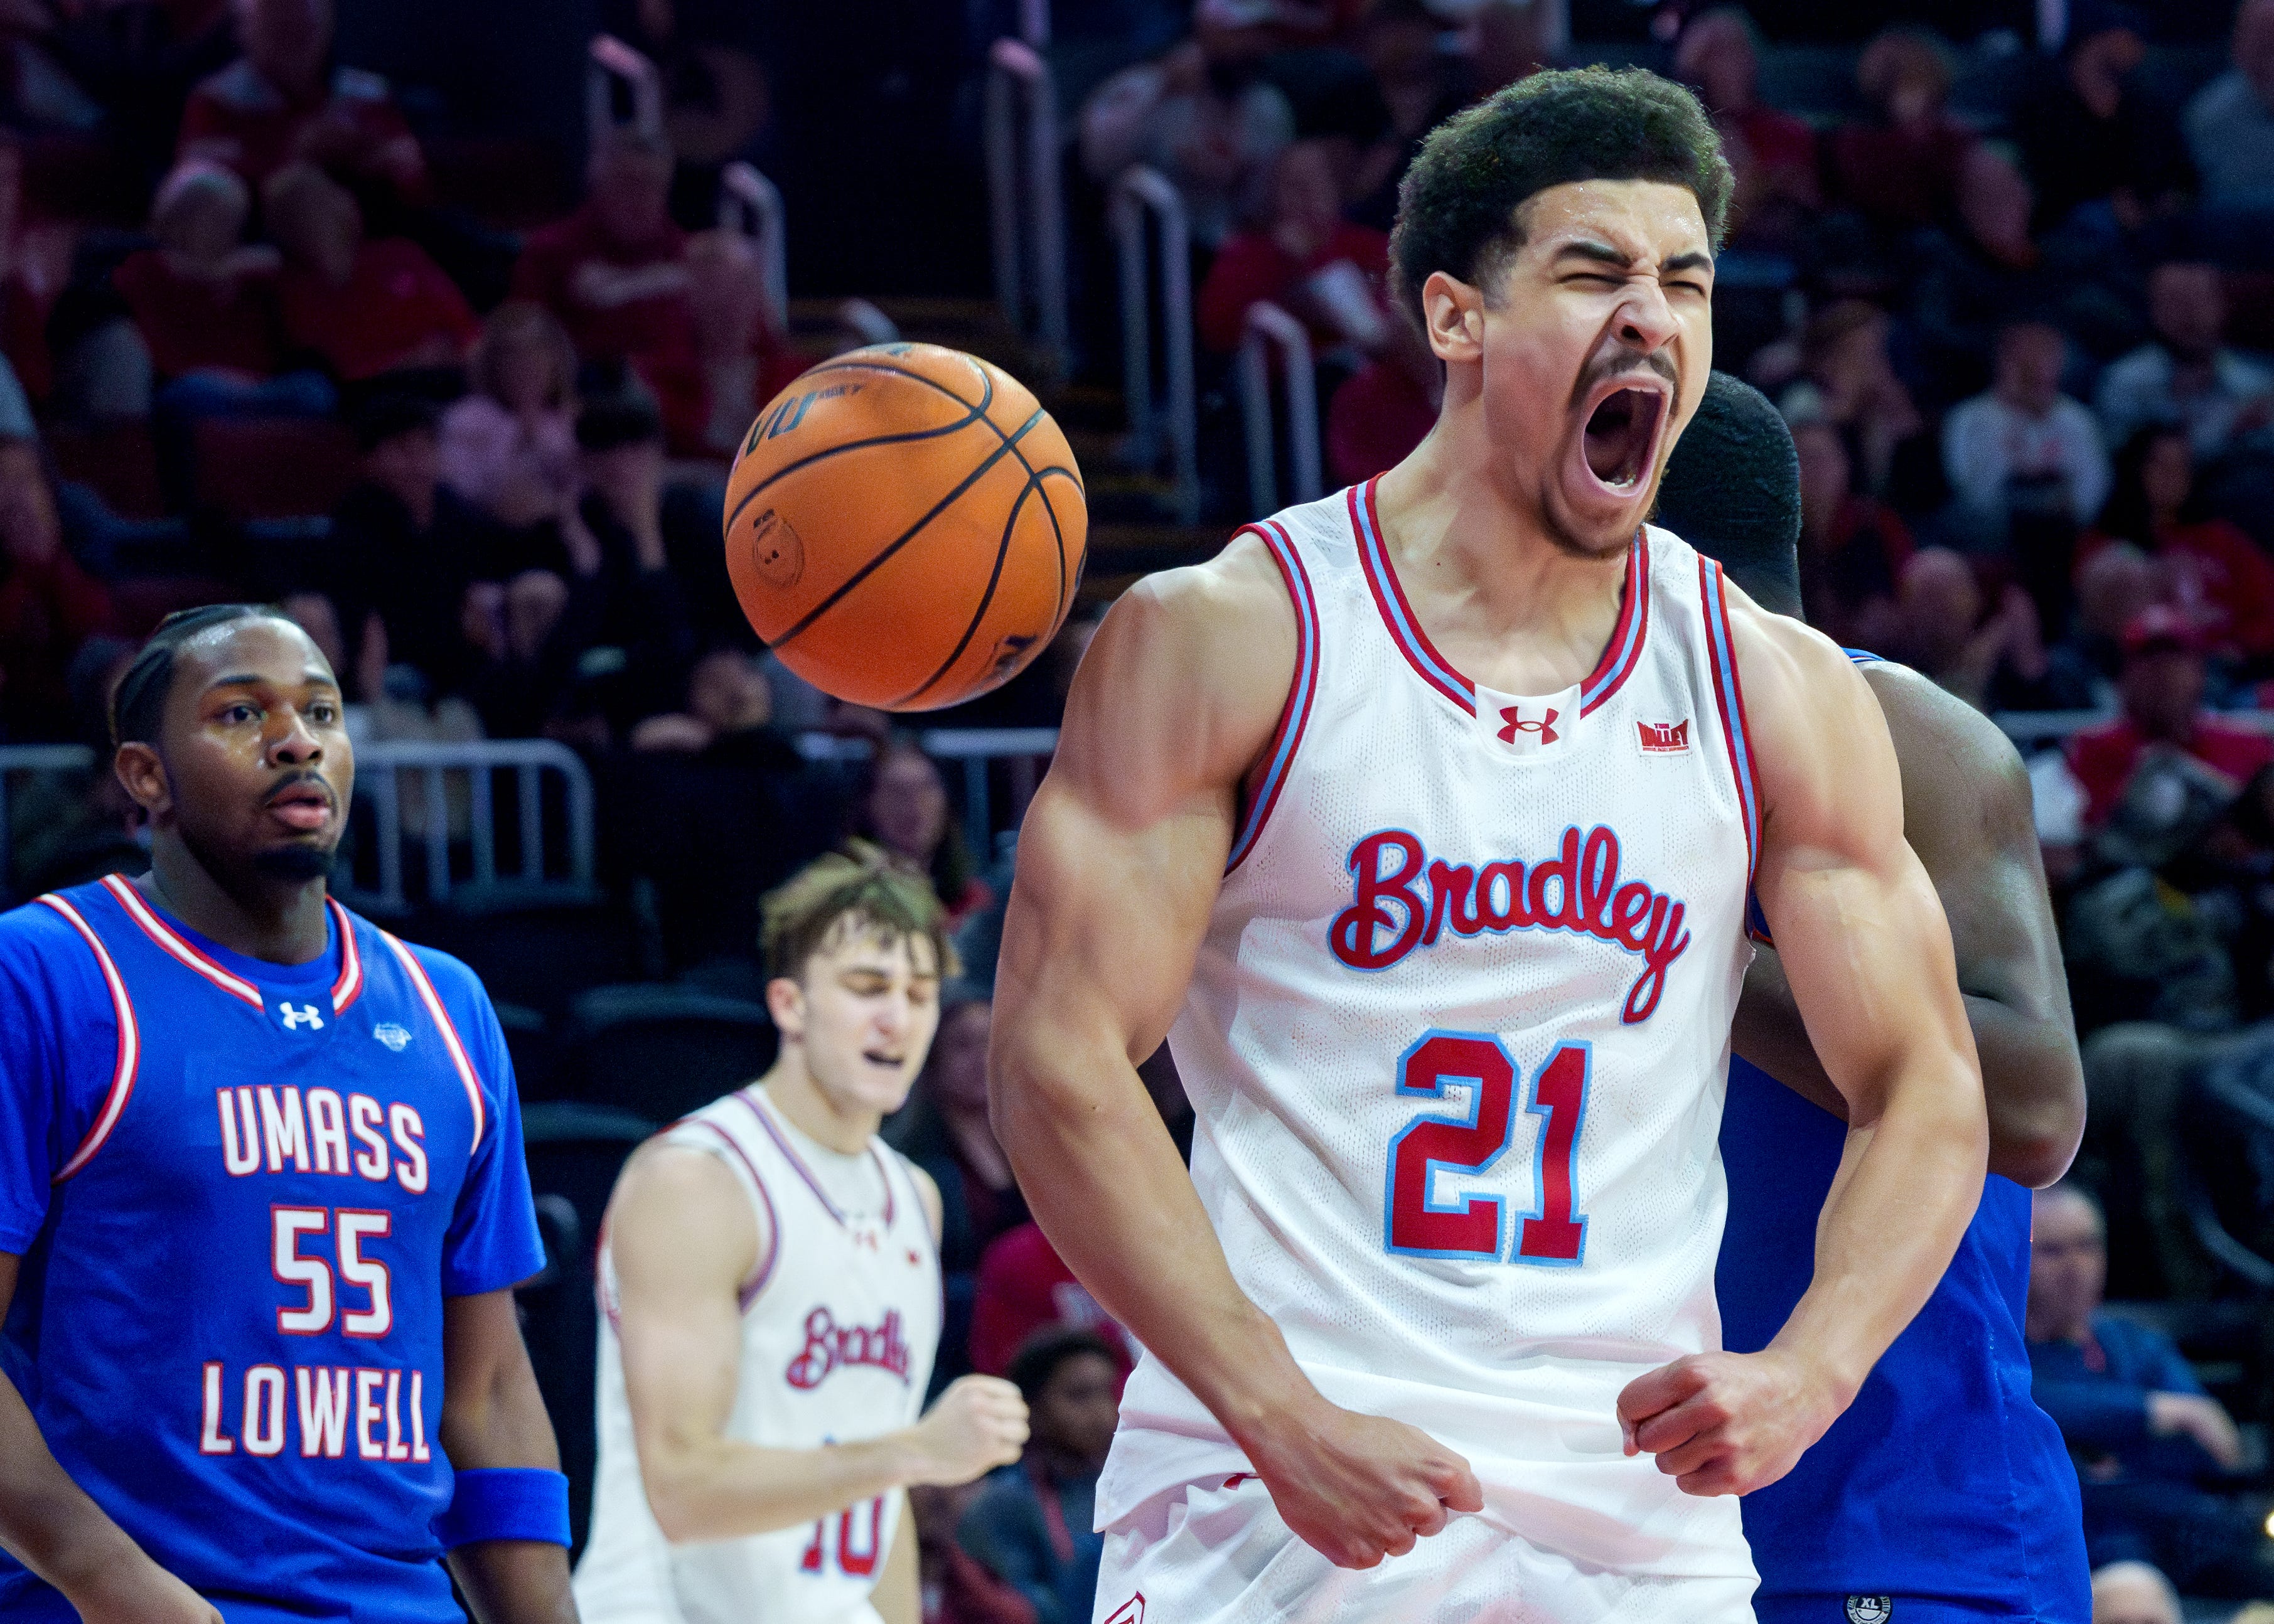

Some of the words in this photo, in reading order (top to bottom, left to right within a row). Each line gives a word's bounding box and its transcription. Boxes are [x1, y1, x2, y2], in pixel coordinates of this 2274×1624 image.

[1327, 823, 1691, 1025] Bradley
[216, 1085, 429, 1195] UMASS
[1385, 1027, 1592, 1266] 21
[270, 1204, 394, 1338] 55
[199, 1360, 431, 1463] LOWELL
[1860, 1596, 1879, 1610] XL
